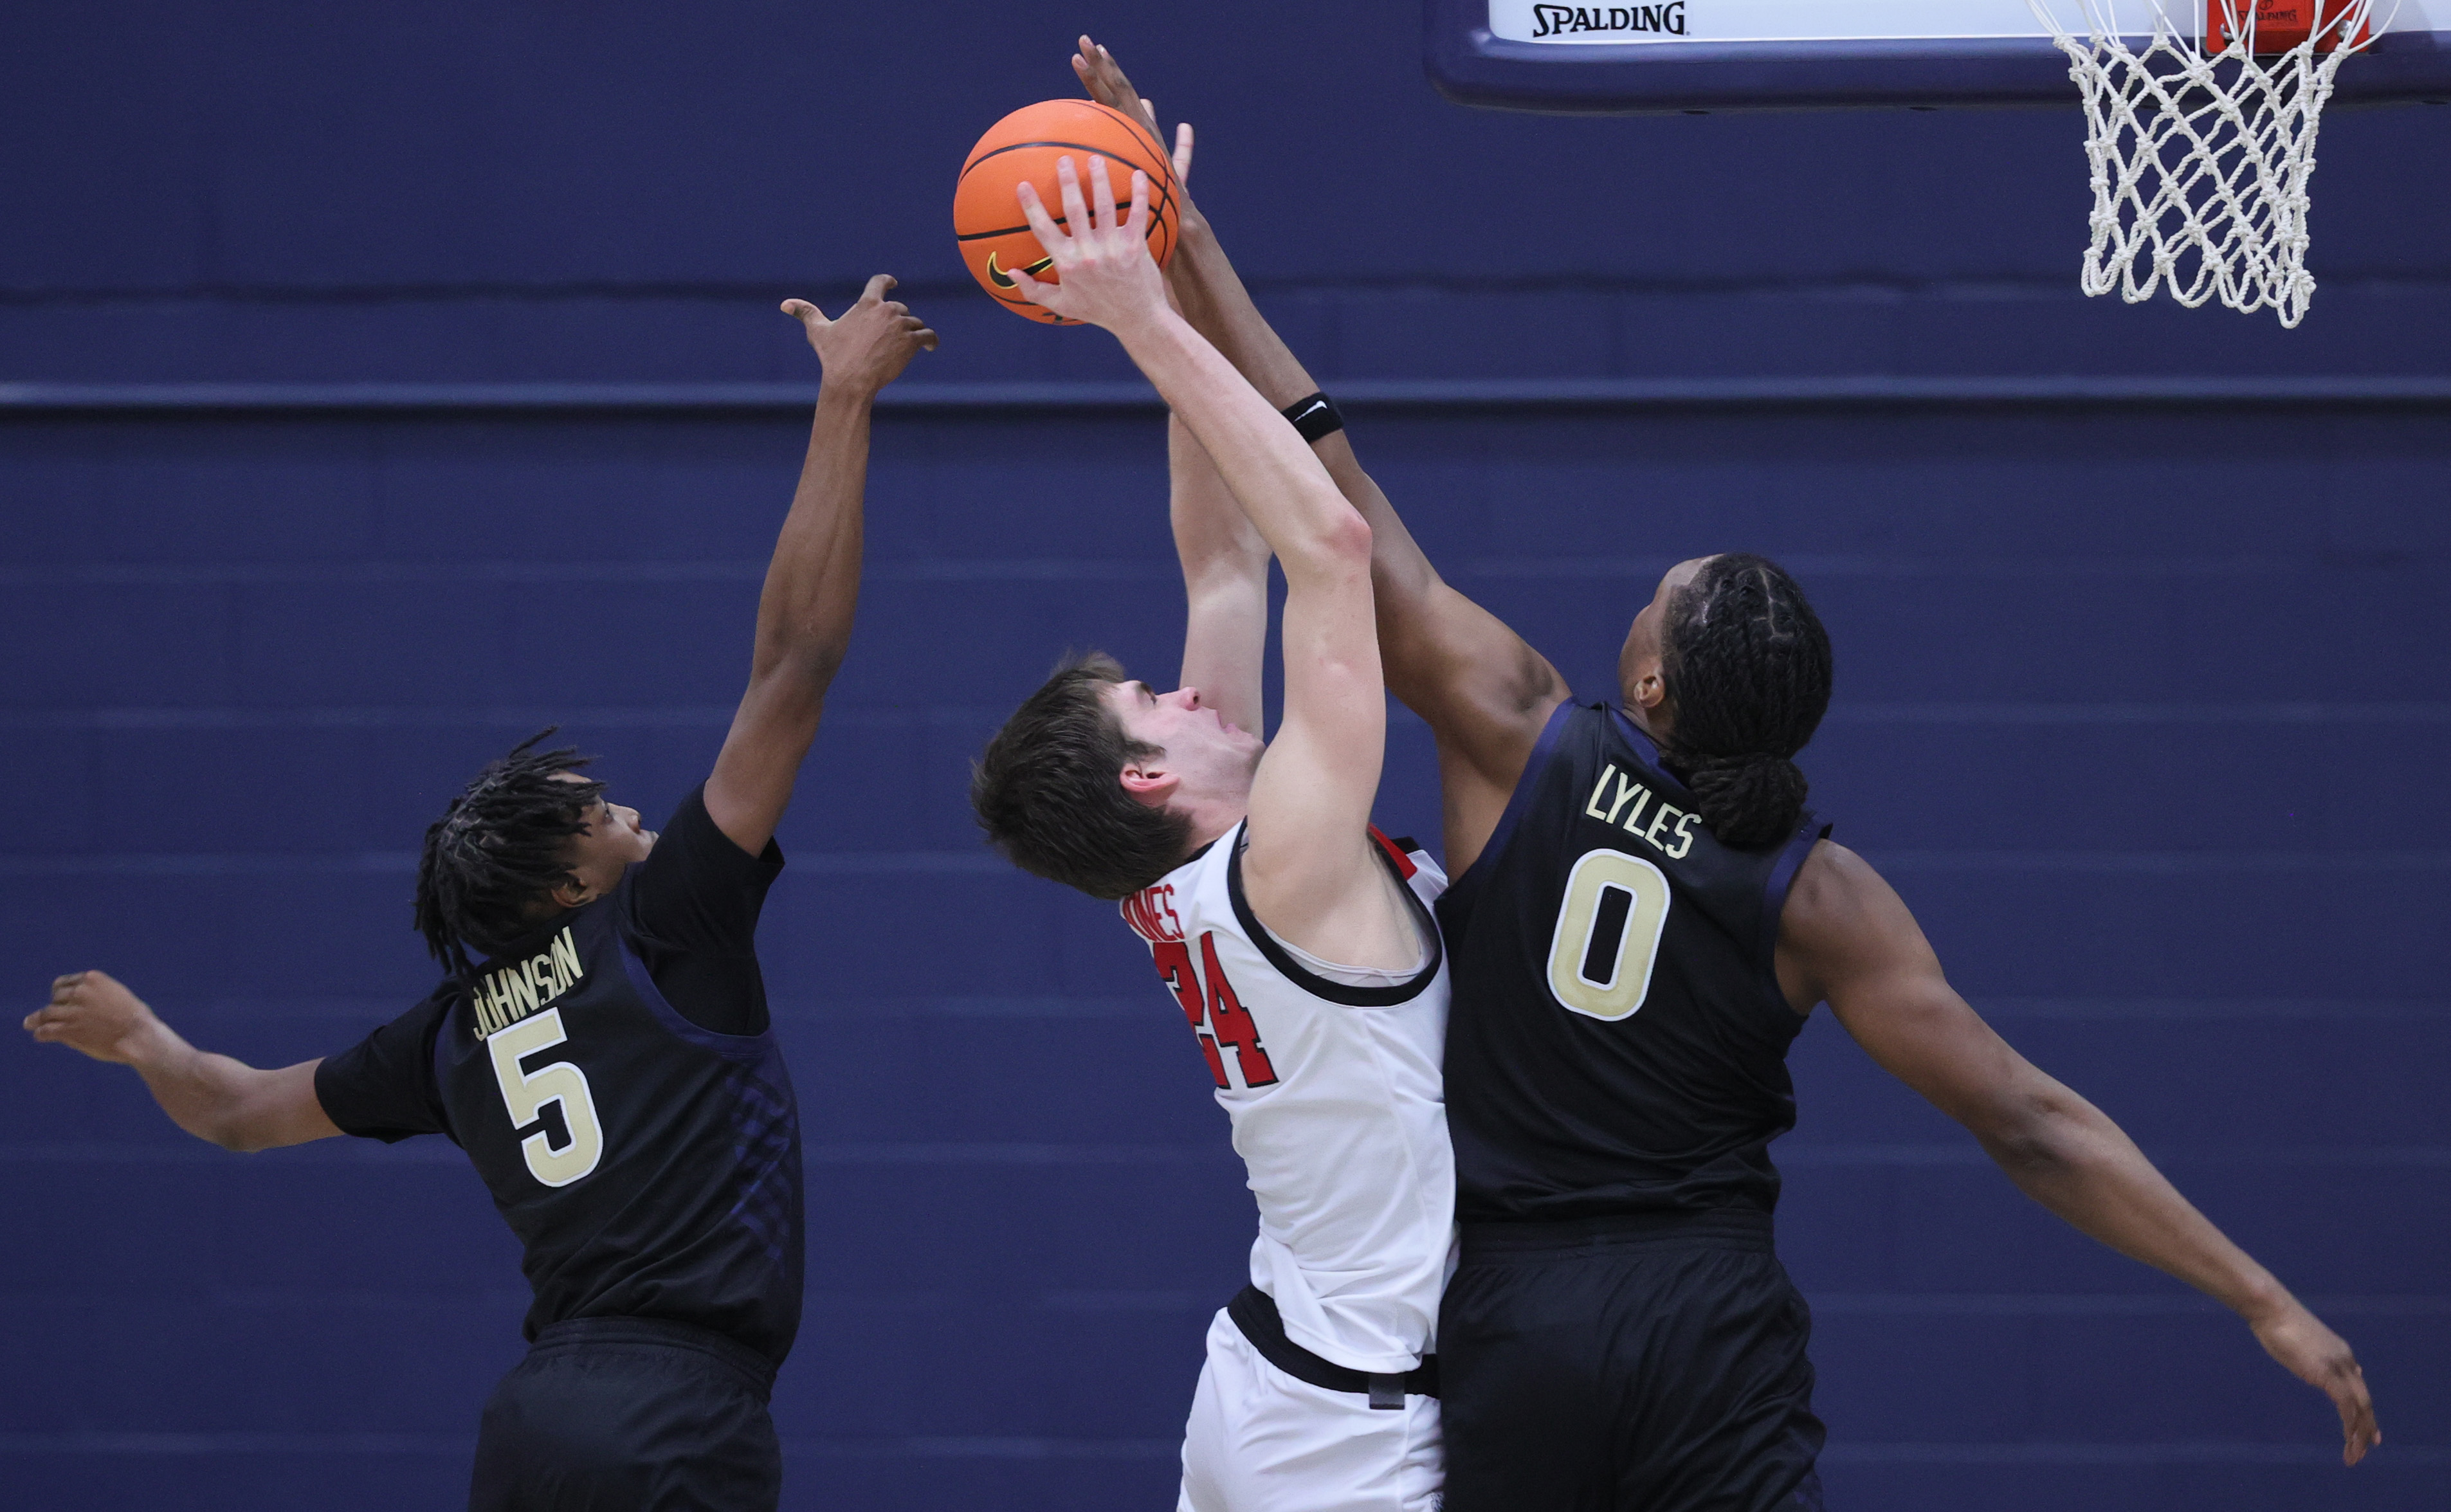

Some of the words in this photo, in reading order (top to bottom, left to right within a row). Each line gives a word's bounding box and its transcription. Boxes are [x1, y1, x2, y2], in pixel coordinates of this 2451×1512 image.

[1533, 1, 1684, 37] SPALDING
[1585, 763, 1702, 859] LYLES
[1122, 884, 1186, 942] ONES
[1546, 848, 1671, 1022] 0
[473, 925, 584, 1042] JOHNSON
[1153, 930, 1279, 1090] 24
[487, 1006, 603, 1187] 5
